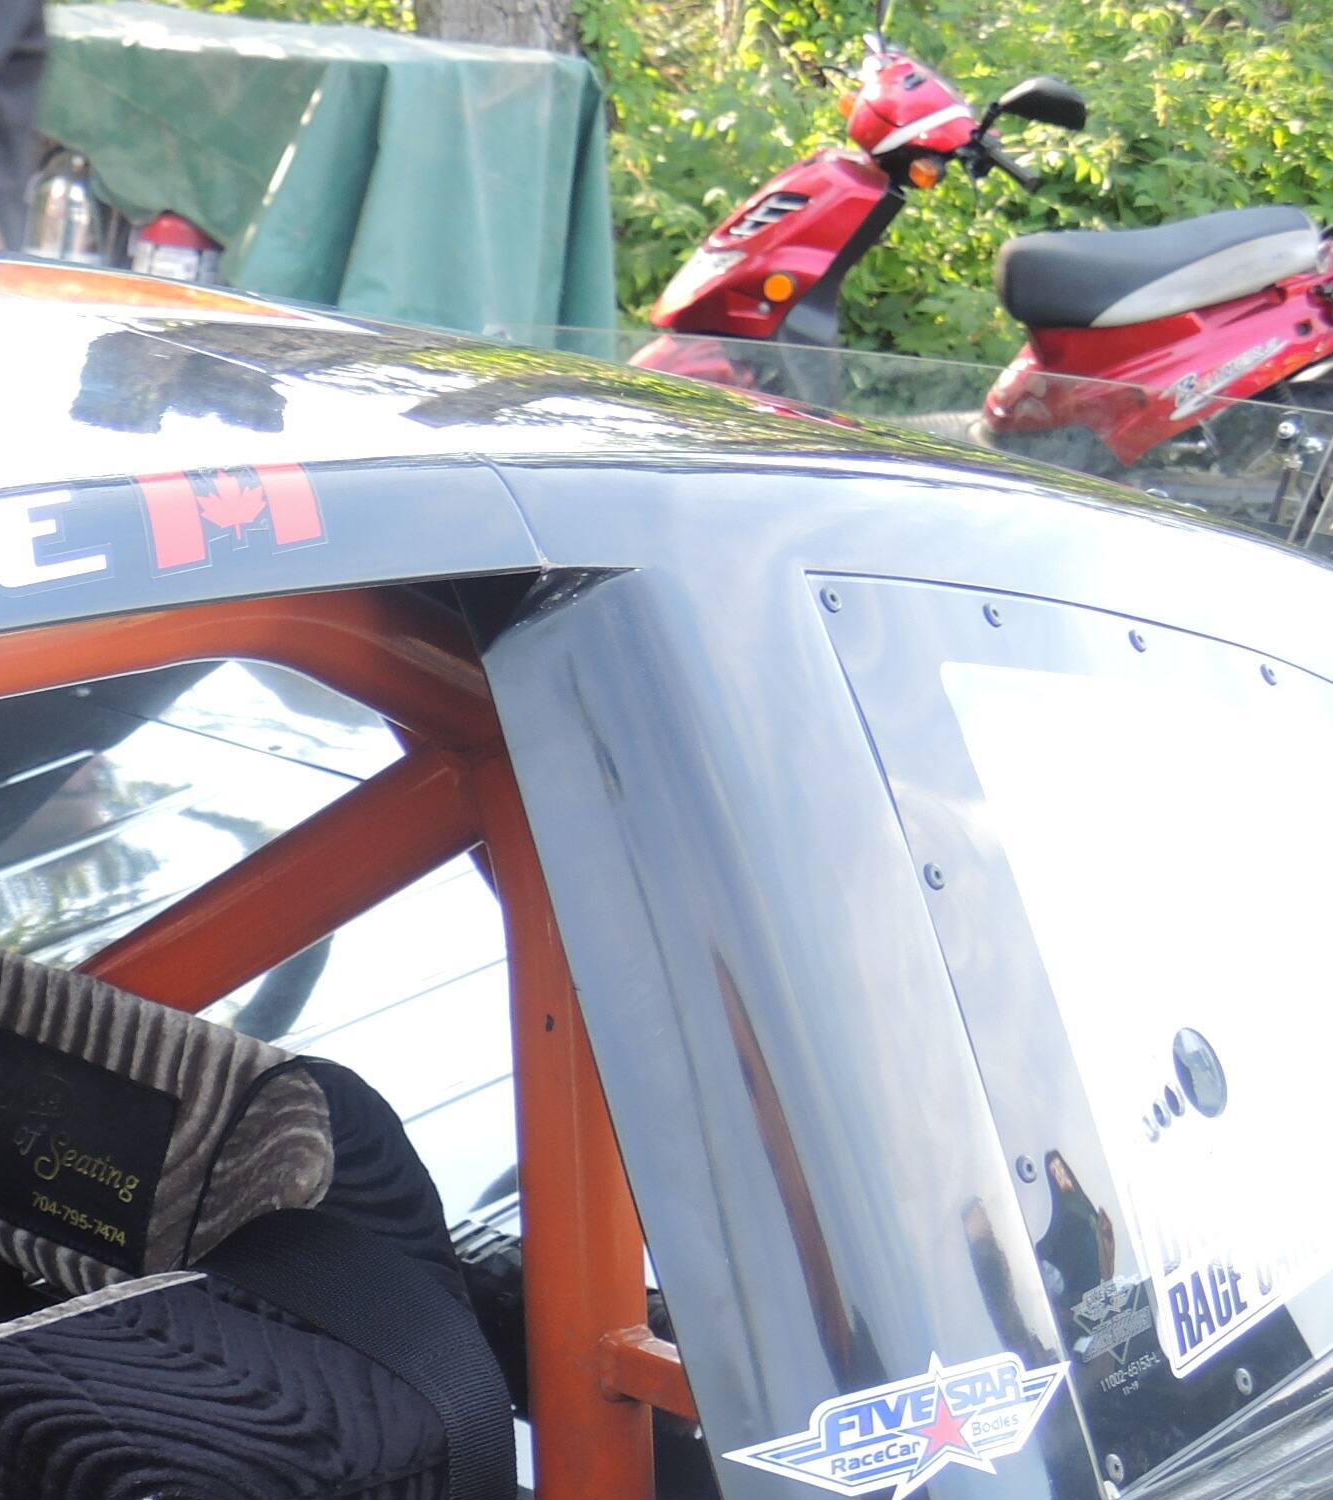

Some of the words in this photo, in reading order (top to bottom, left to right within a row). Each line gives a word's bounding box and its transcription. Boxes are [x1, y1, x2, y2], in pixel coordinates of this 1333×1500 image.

[33, 1126, 141, 1203] Seating
[32, 1190, 127, 1247] 704-795-7474
[1168, 1262, 1248, 1358] RACE
[824, 1386, 937, 1452] FIVE
[945, 1365, 1023, 1414] STAR
[830, 1440, 921, 1477] RaceCar
